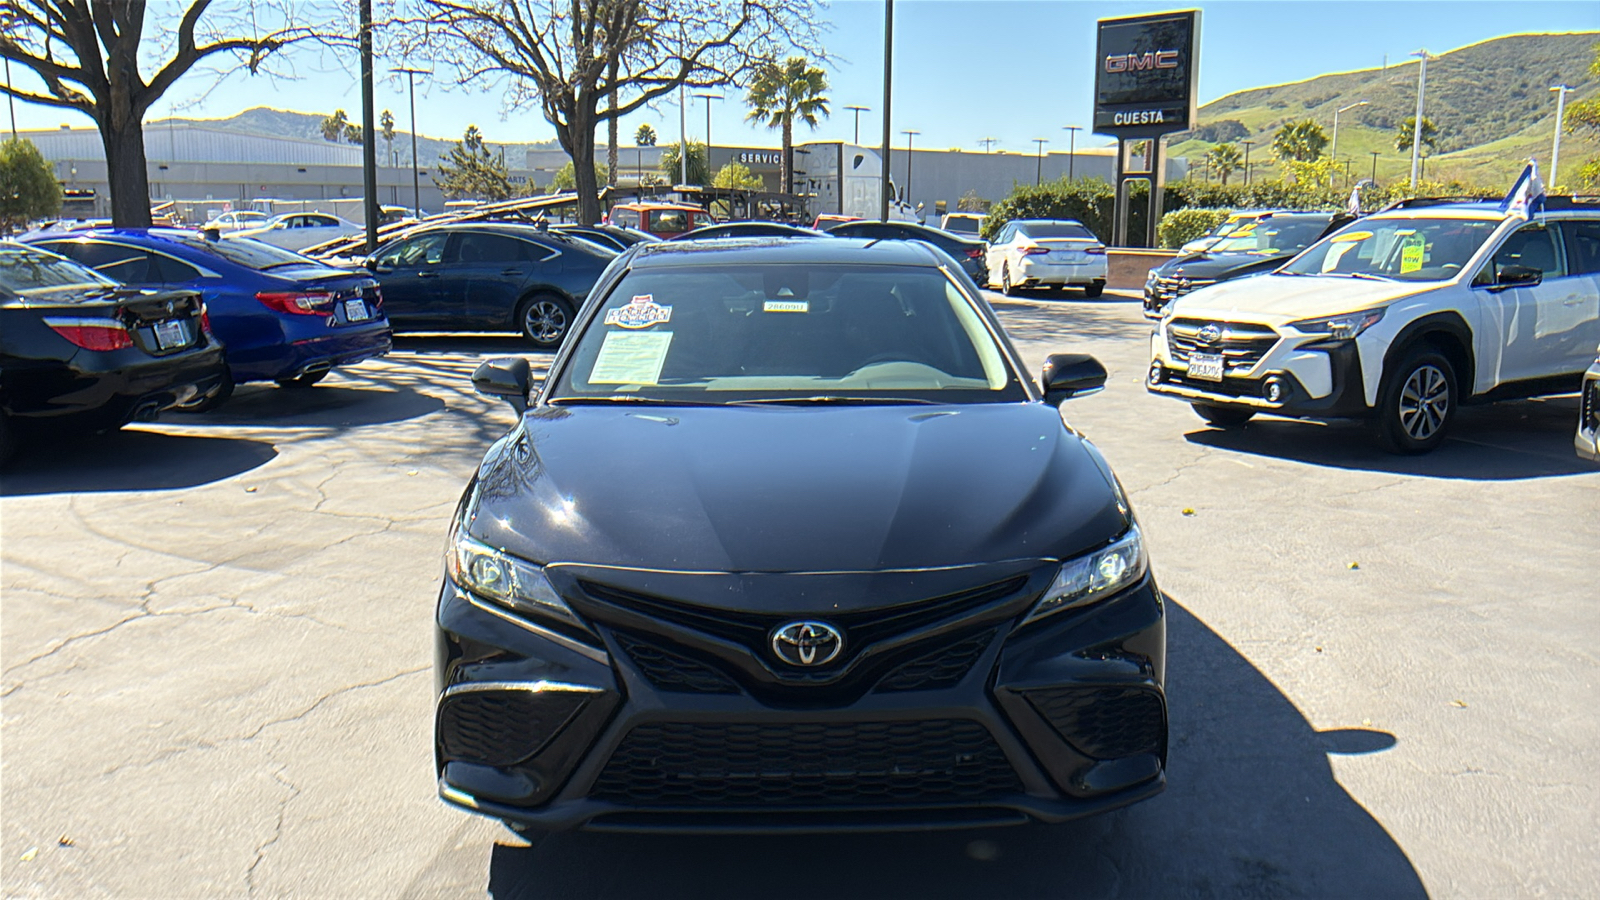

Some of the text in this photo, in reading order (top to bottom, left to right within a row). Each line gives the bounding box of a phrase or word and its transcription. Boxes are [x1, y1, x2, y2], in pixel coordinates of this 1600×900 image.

[1105, 49, 1179, 73] GMC
[1114, 110, 1164, 125] CUESTA
[504, 175, 527, 184] ARTS
